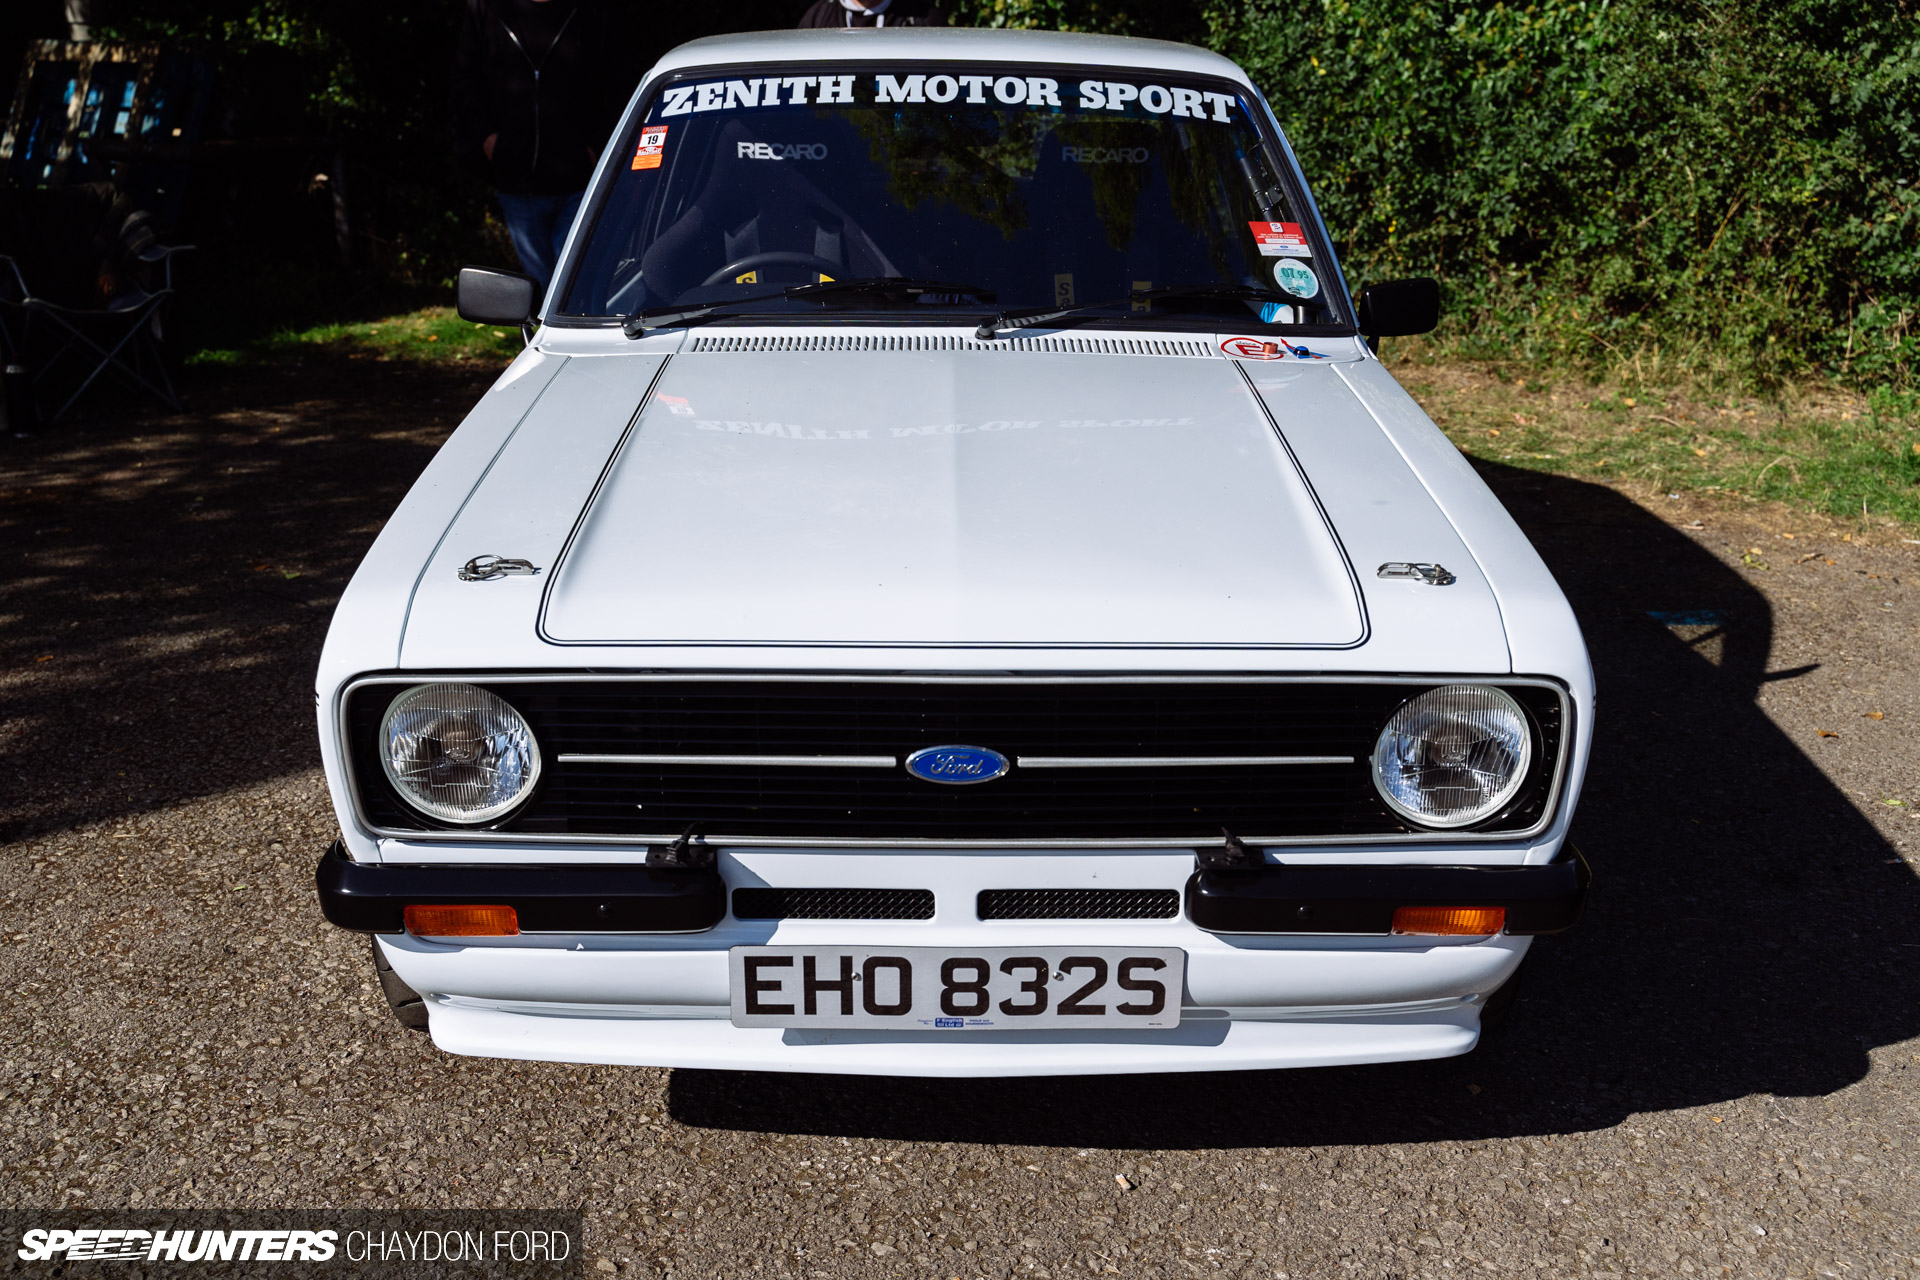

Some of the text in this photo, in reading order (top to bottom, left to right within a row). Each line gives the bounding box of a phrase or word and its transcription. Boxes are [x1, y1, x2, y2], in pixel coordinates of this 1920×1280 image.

[661, 75, 1235, 124] ZENITH MOTOR SPORT
[647, 134, 659, 145] 19
[737, 141, 828, 160] RECARO
[1062, 146, 1149, 164] RECARO
[931, 754, 984, 775] Ford
[743, 955, 1168, 1017] EHO 832S
